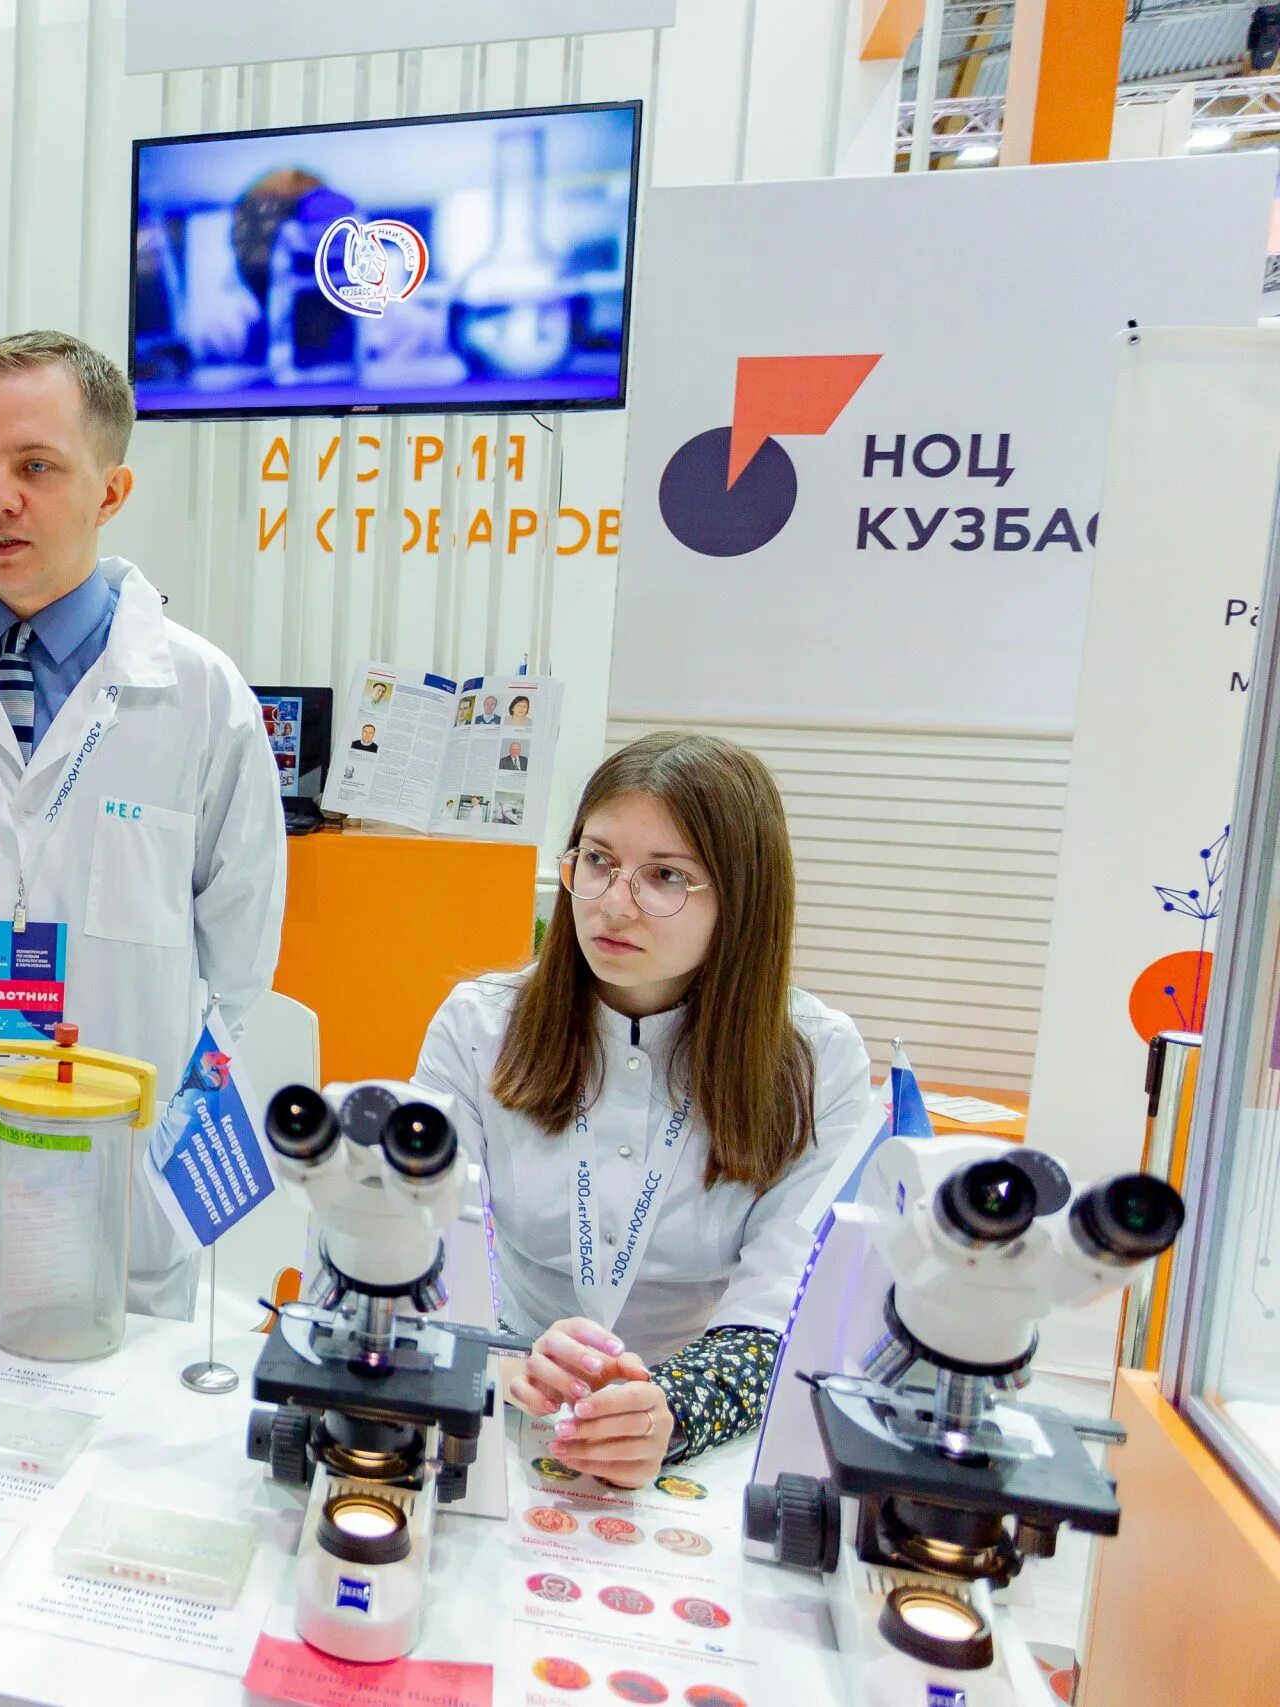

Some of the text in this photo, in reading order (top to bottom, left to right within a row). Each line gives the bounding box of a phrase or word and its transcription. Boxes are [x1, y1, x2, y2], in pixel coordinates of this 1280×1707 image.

[863, 433, 1015, 487] НОЦ
[856, 507, 1100, 553] КУЗБА
[177, 1148, 223, 1226] университет
[191, 1132, 236, 1217] медицинский
[192, 1096, 248, 1207] Государственный
[220, 1113, 259, 1197] Кемеровский
